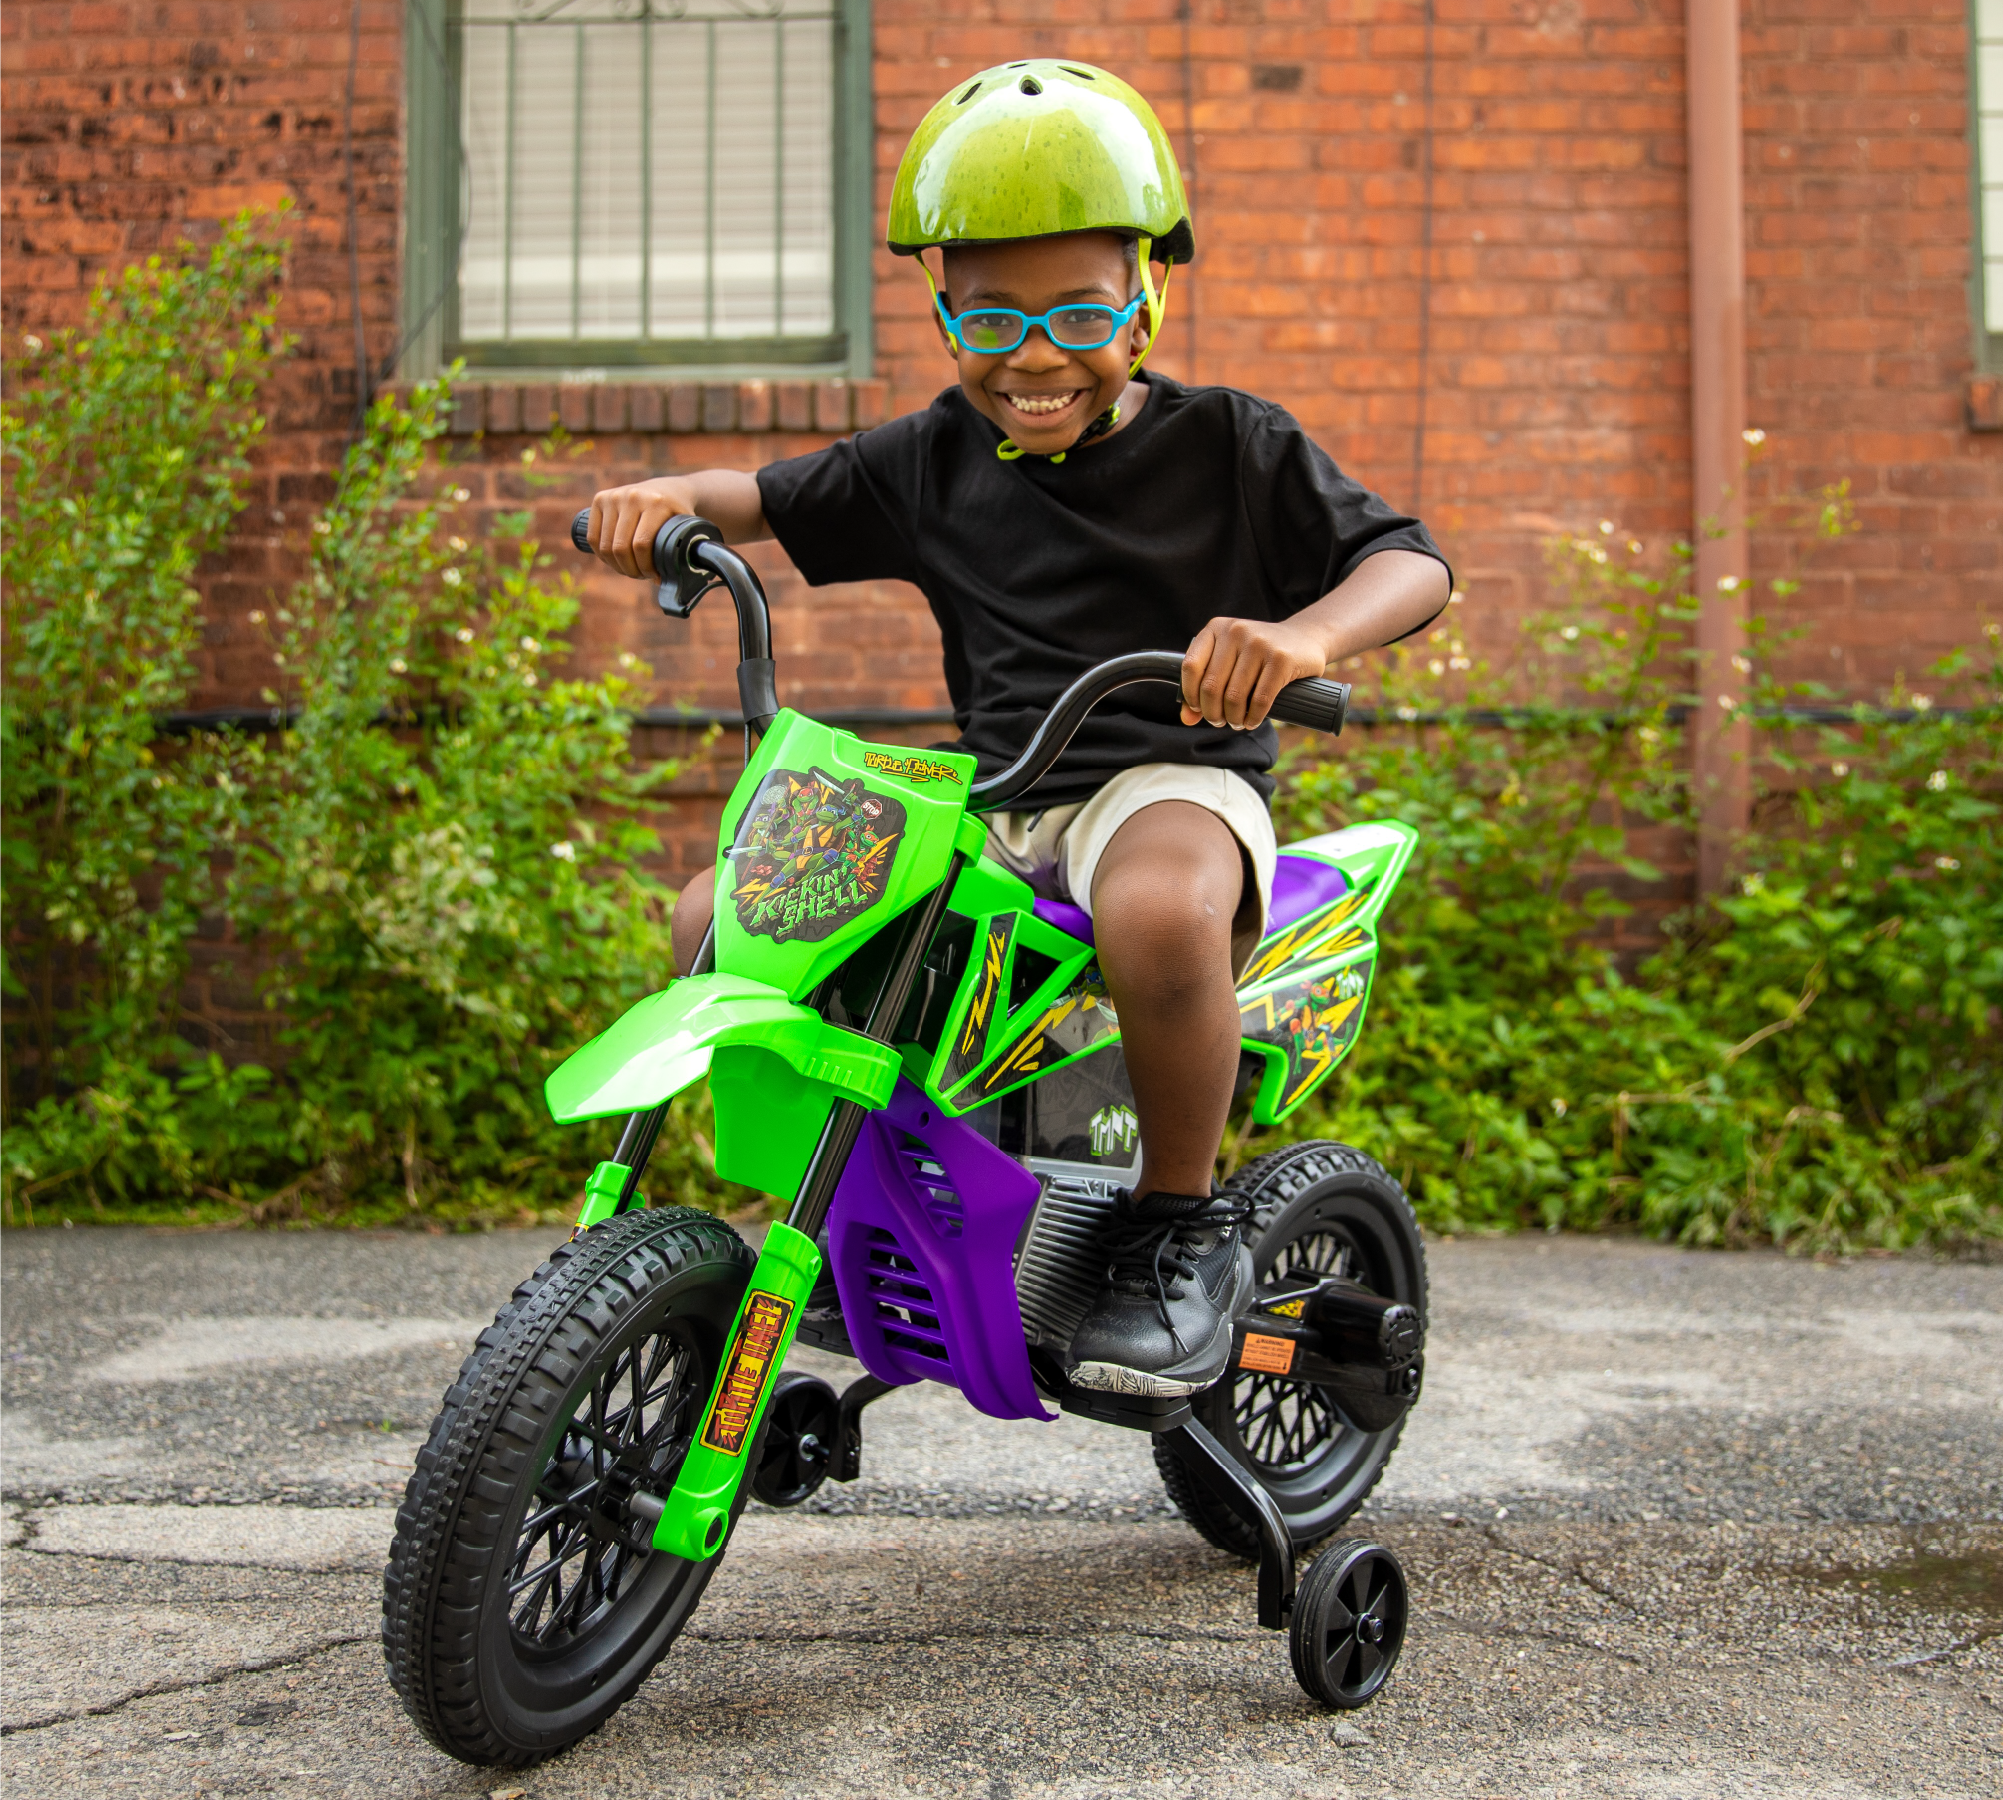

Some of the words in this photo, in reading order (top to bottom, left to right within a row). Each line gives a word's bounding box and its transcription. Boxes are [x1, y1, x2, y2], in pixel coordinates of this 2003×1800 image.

[864, 752, 903, 771] TURTLE
[863, 802, 880, 815] STOP
[776, 880, 868, 936] SHELL
[1089, 1104, 1139, 1156] TMNT
[714, 1363, 762, 1441] TURTLE
